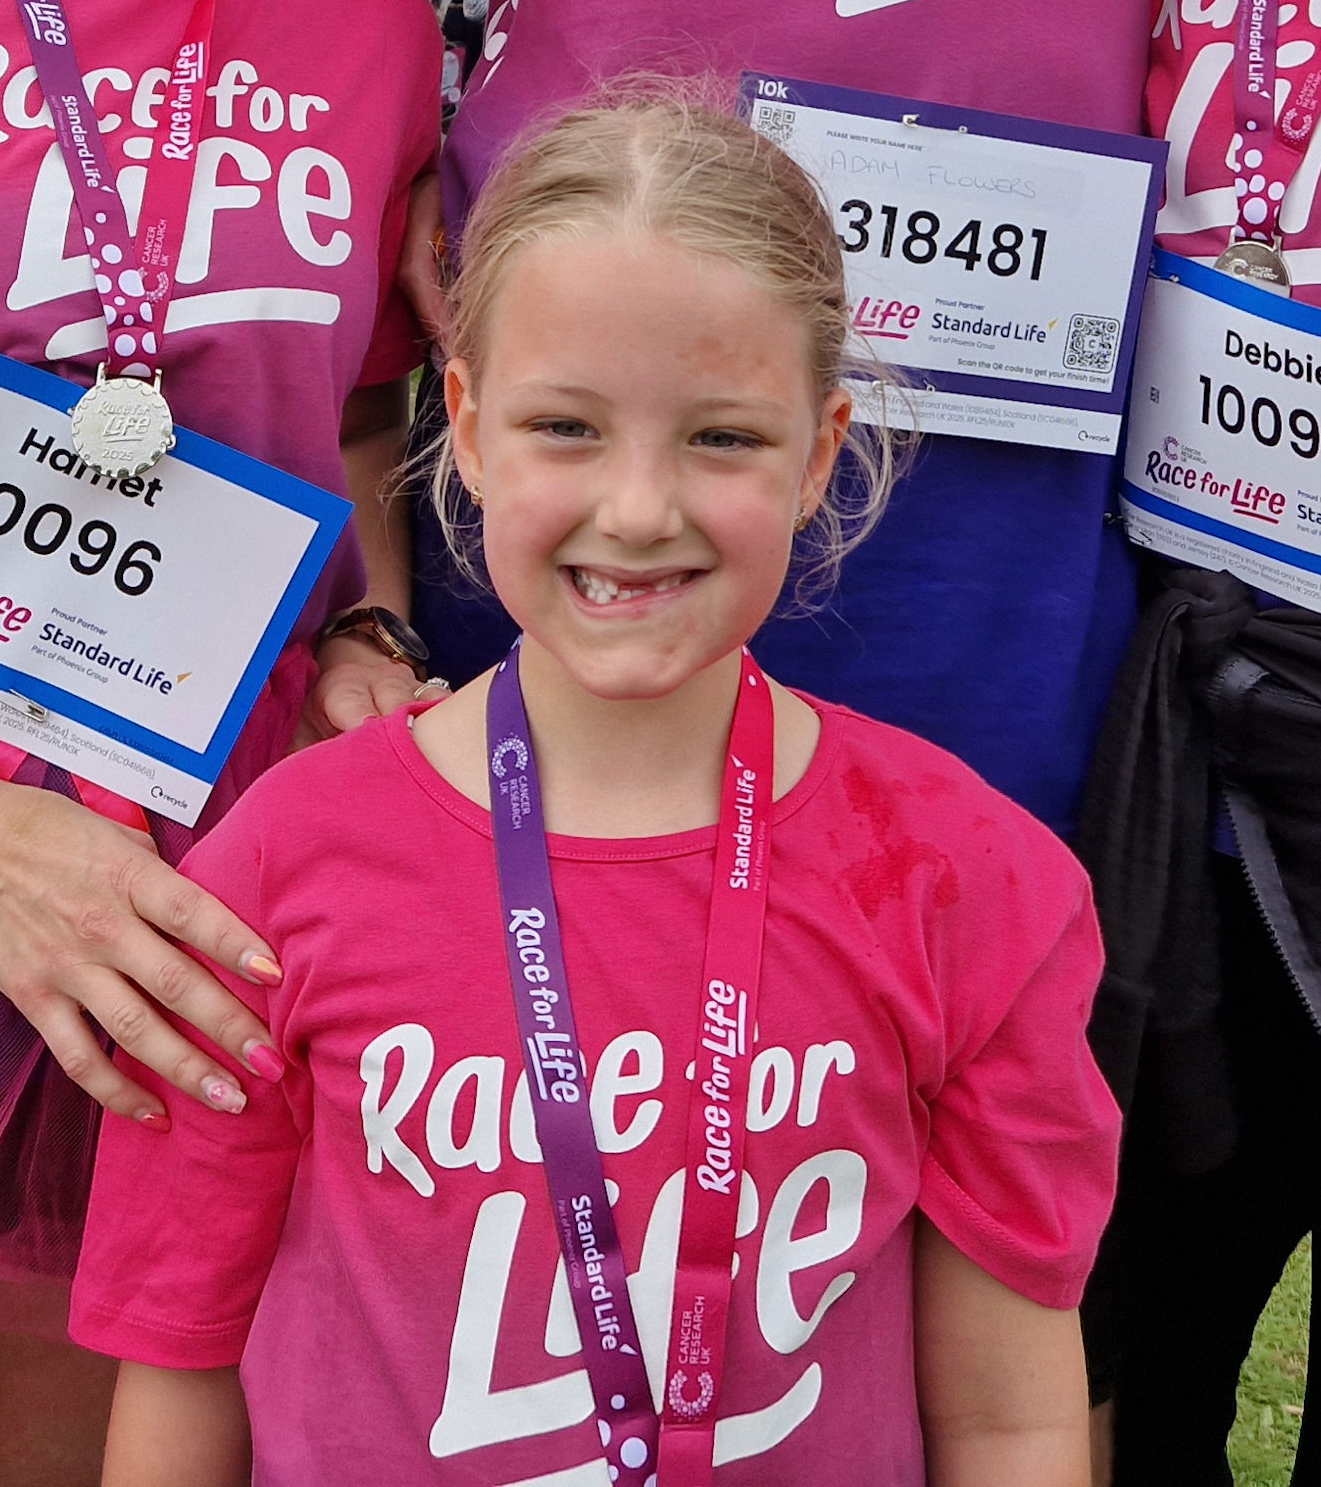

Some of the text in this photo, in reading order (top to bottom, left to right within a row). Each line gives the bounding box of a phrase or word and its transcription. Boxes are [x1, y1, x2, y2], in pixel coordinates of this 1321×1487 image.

[205, 59, 330, 132] for
[757, 79, 790, 100] 10k
[1248, 64, 1264, 92] Life
[162, 43, 203, 159] Race for Life
[62, 96, 101, 187] Standard Life
[830, 150, 901, 179] ADAM
[141, 225, 156, 263] CANCER
[150, 218, 167, 265] RESEARCH
[160, 253, 169, 267] UK
[838, 199, 1048, 281] 318481
[852, 297, 922, 331] Life
[934, 297, 985, 310] Proud Partner
[932, 312, 1047, 344] Standard Life
[957, 358, 978, 370] Scan
[979, 360, 990, 370] the
[1048, 371, 1065, 382] your
[102, 412, 152, 437] Life
[18, 426, 164, 506] Haet
[100, 447, 134, 462] 2025
[1144, 449, 1197, 491] Race
[1200, 473, 1231, 499] for
[1230, 477, 1287, 515] Life
[50, 607, 109, 638] Proud Partner
[30, 643, 109, 685] Part of Phoenix Group
[39, 624, 174, 695] Standard Life
[498, 781, 509, 795] UK
[503, 778, 526, 829] RESEARCH
[514, 775, 534, 815] CANCER
[730, 770, 755, 889] Standard Life
[509, 908, 579, 1102] Race for Life
[684, 1028, 856, 1133] or
[697, 980, 746, 1194] Race for Life
[572, 1196, 626, 1349] Standard Life
[677, 1309, 694, 1364] CANCER
[687, 1295, 707, 1364] RESEARCH
[699, 1346, 711, 1364] UK
